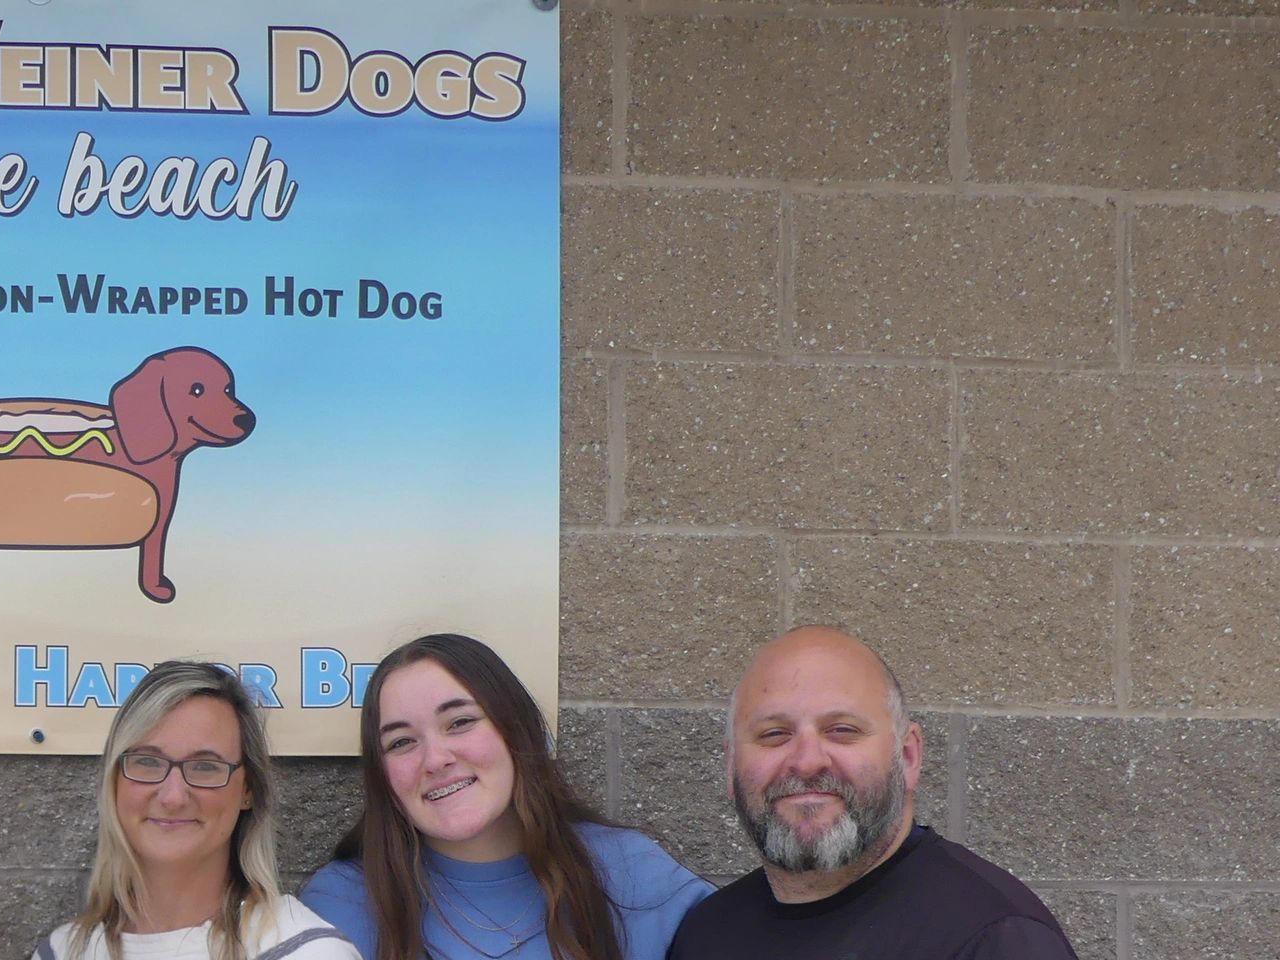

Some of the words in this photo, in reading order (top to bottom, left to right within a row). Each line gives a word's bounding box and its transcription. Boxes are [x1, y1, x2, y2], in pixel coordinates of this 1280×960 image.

[268, 26, 526, 121] DOGS
[56, 131, 297, 219] beach
[265, 275, 344, 318] HOT
[358, 278, 443, 320] DOG
